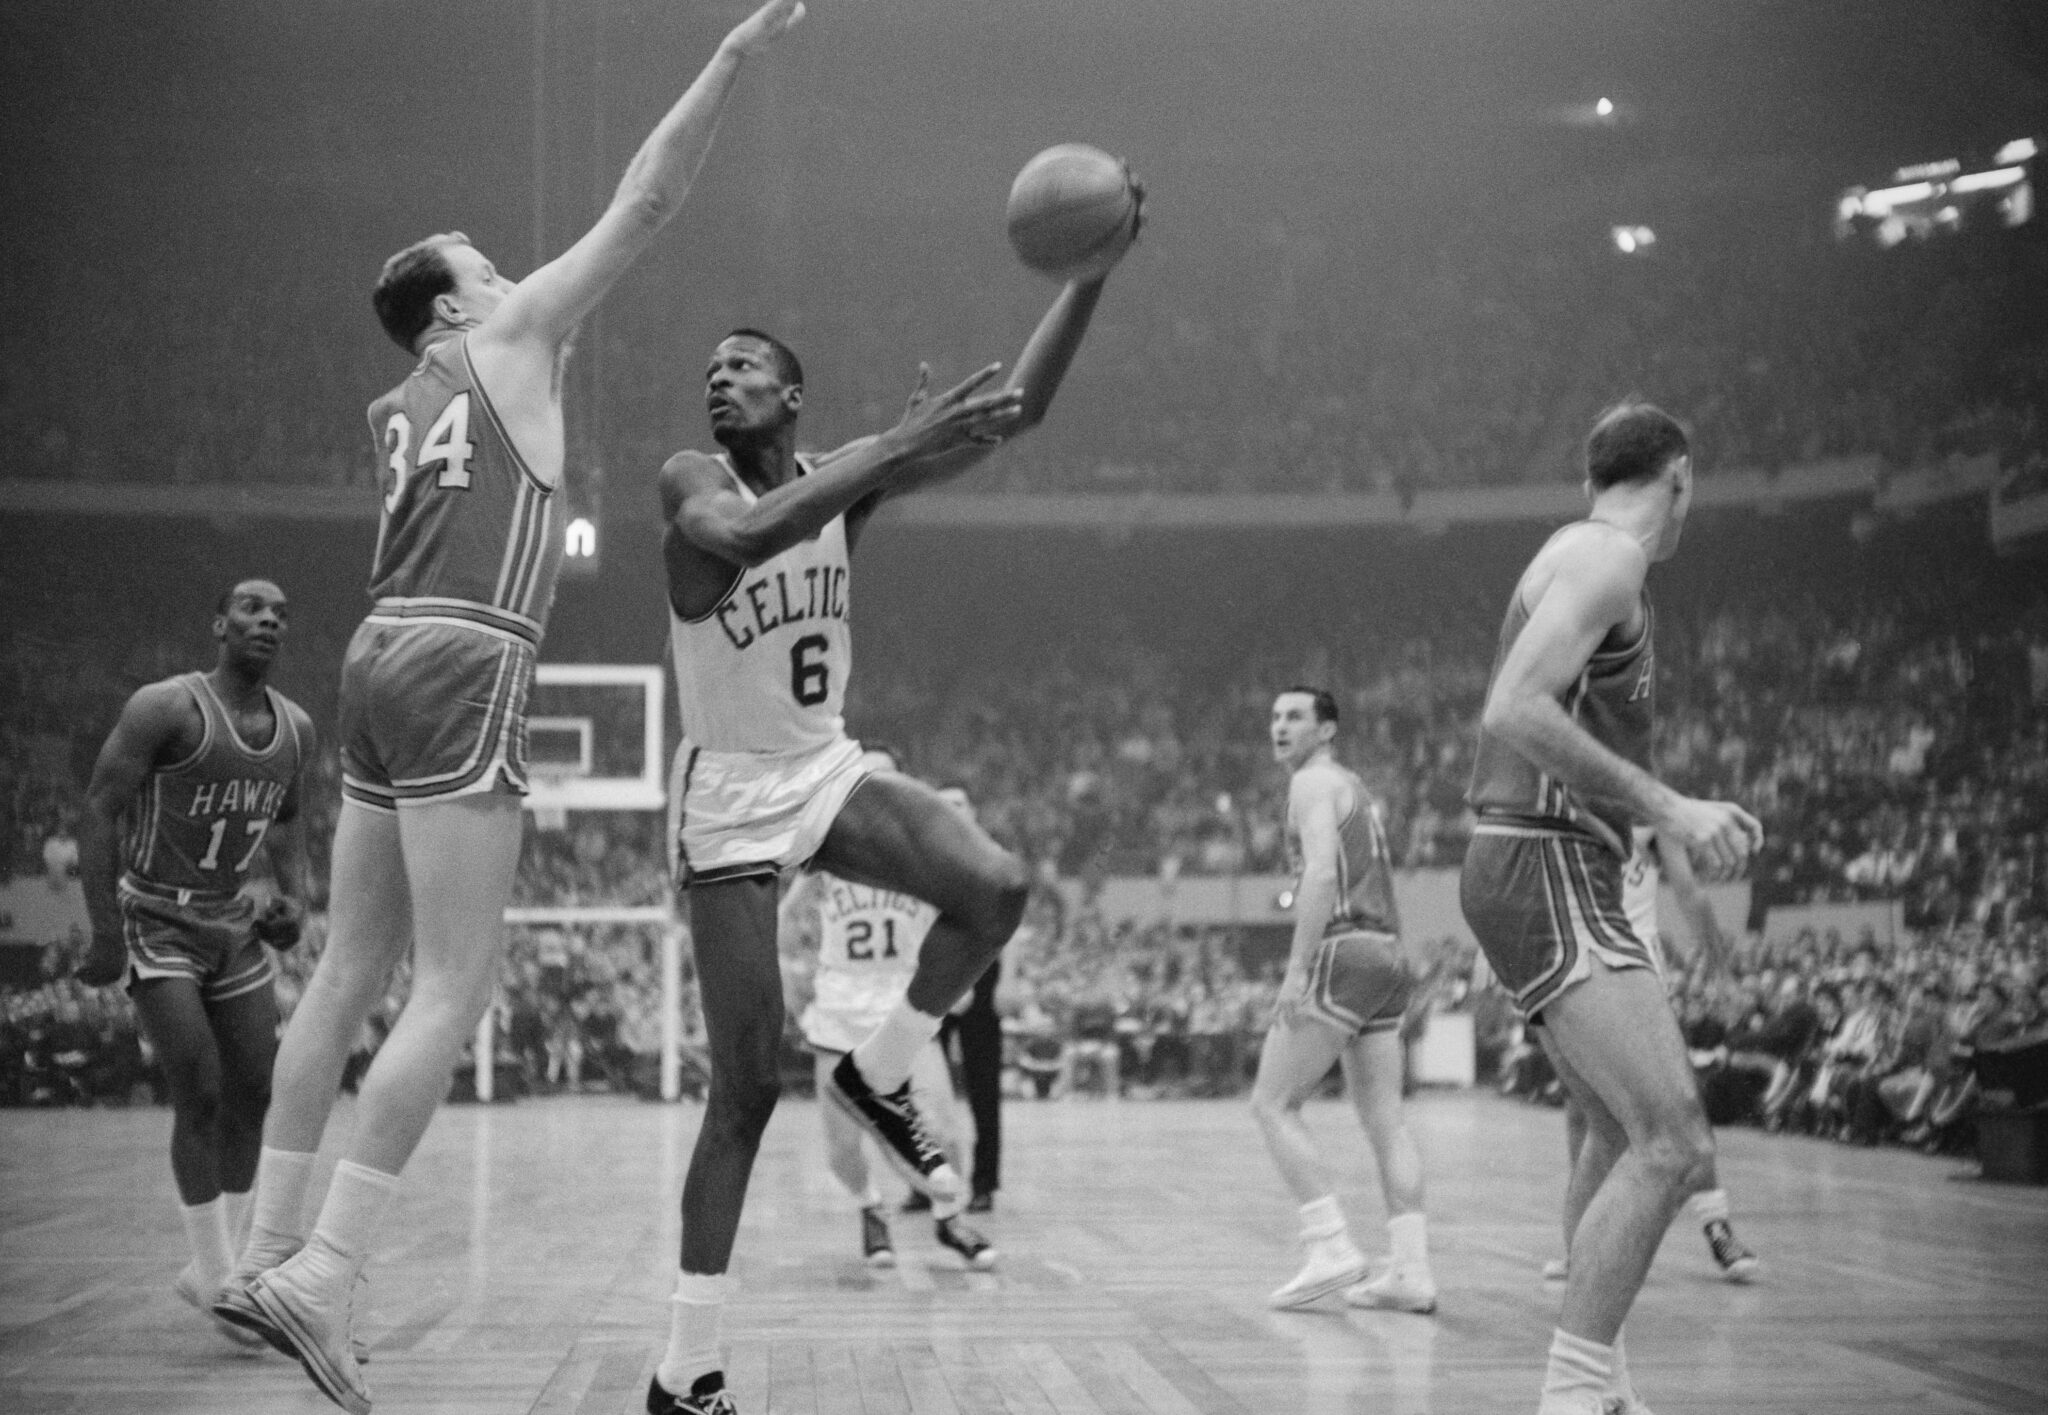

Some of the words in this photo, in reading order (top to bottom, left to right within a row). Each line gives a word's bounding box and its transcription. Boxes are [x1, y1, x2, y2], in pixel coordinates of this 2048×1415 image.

[385, 389, 474, 514] 34
[716, 565, 849, 651] CELTIC
[790, 633, 829, 707] 6
[198, 818, 269, 873] 17
[846, 918, 897, 960] 21
